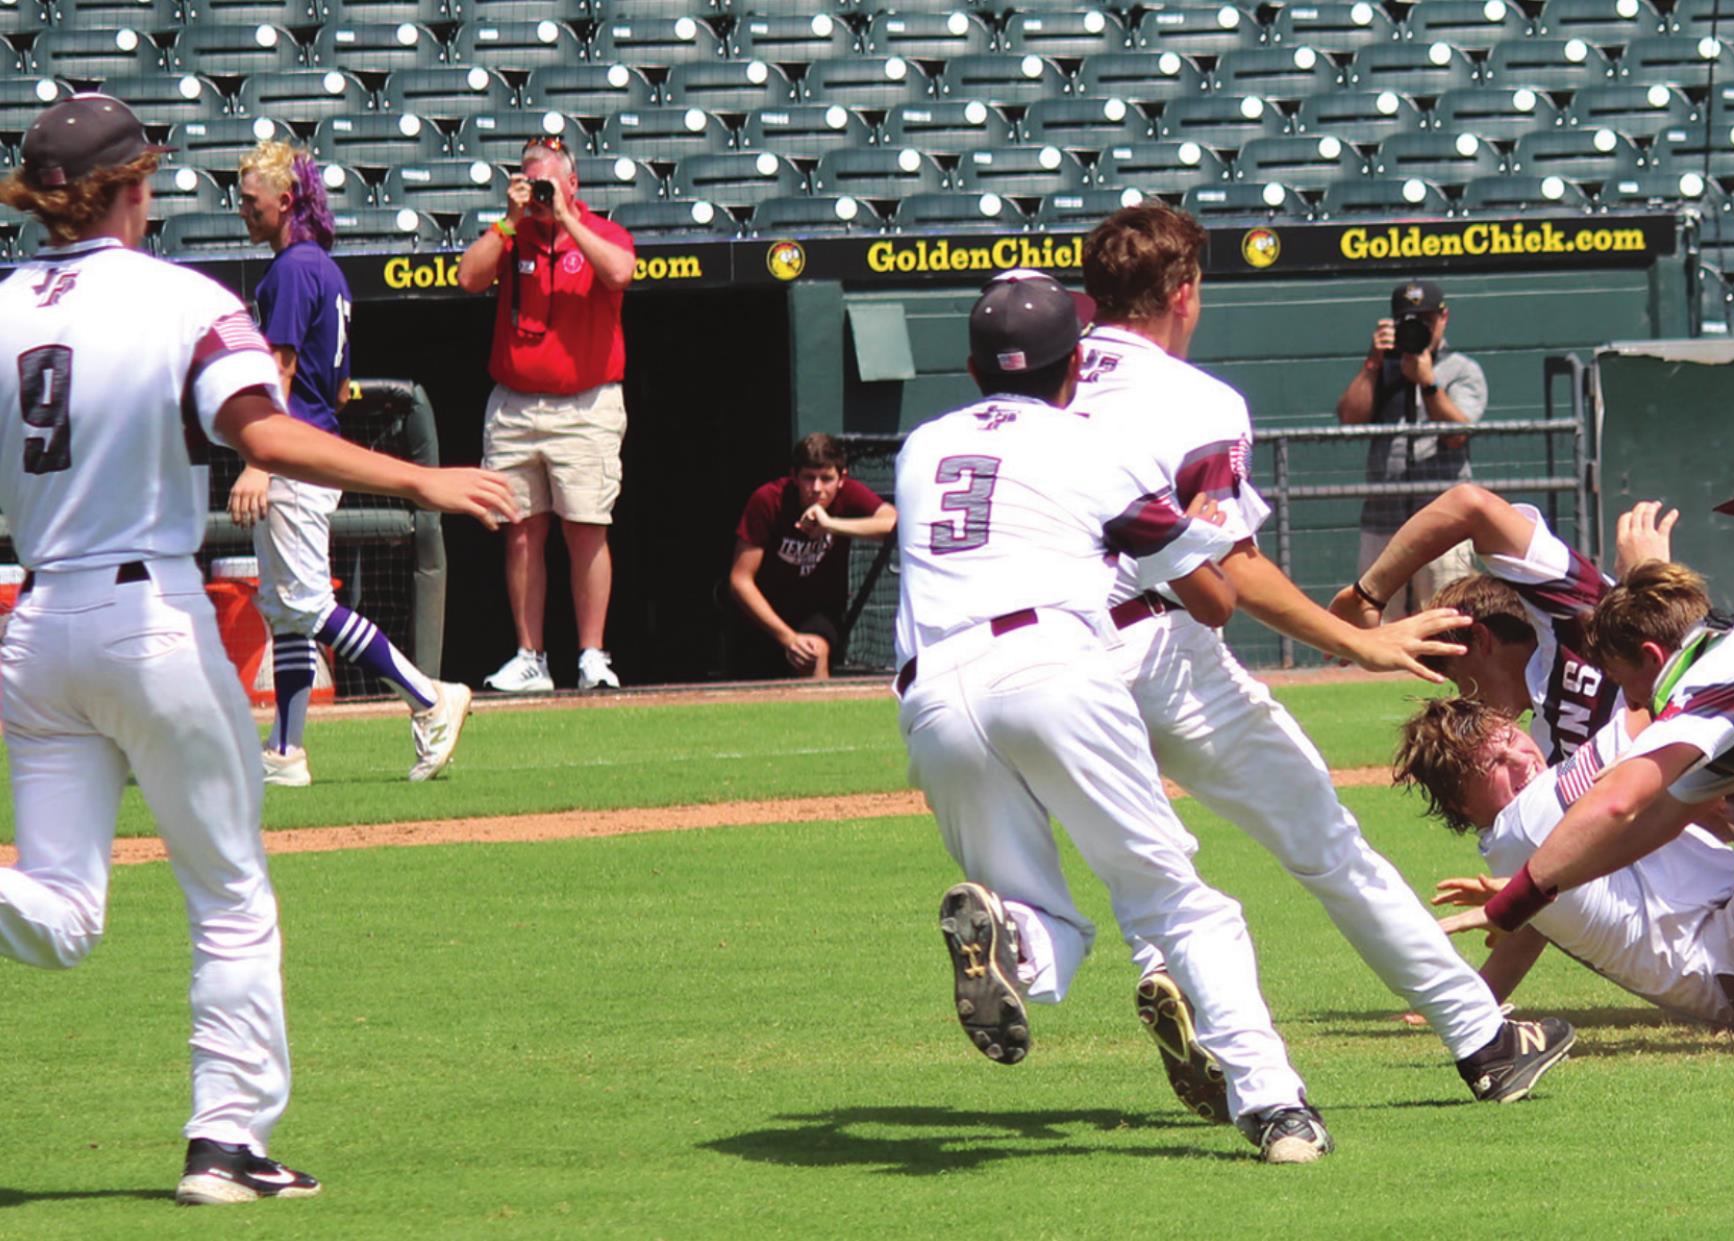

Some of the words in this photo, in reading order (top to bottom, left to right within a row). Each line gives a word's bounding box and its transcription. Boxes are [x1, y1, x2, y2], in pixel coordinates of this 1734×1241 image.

[1341, 223, 1646, 259] GoldenChick.com
[17, 343, 74, 475] 9
[929, 455, 1002, 555] 3
[1518, 1024, 1546, 1055] N
